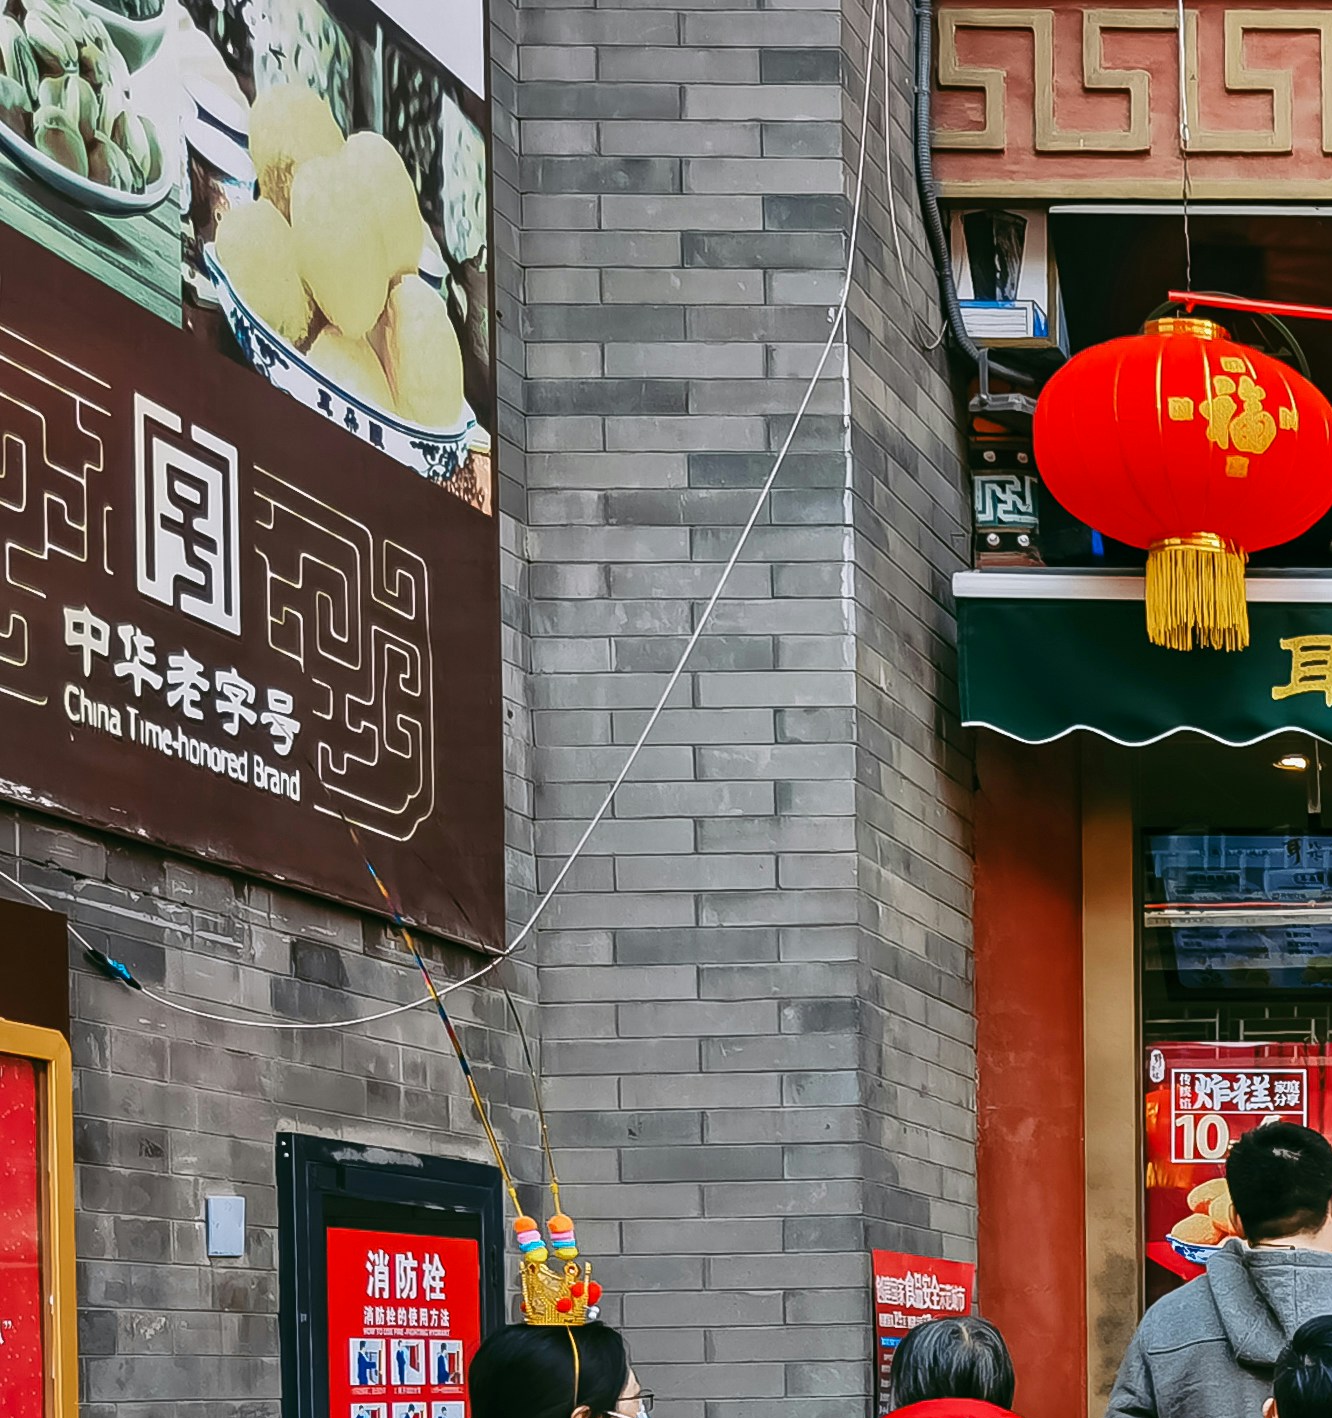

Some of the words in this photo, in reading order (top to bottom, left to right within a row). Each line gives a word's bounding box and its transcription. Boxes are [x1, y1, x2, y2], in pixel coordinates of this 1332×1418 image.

[62, 604, 301, 756] 中华老字号
[64, 684, 122, 737] China
[128, 708, 248, 780] Time-honored
[253, 757, 301, 802] Brand
[1192, 1073, 1275, 1112] 炸糕
[1175, 1113, 1230, 1160] 10
[365, 1248, 446, 1301] 消防栓
[364, 1305, 450, 1327] 消防栓的使用方法
